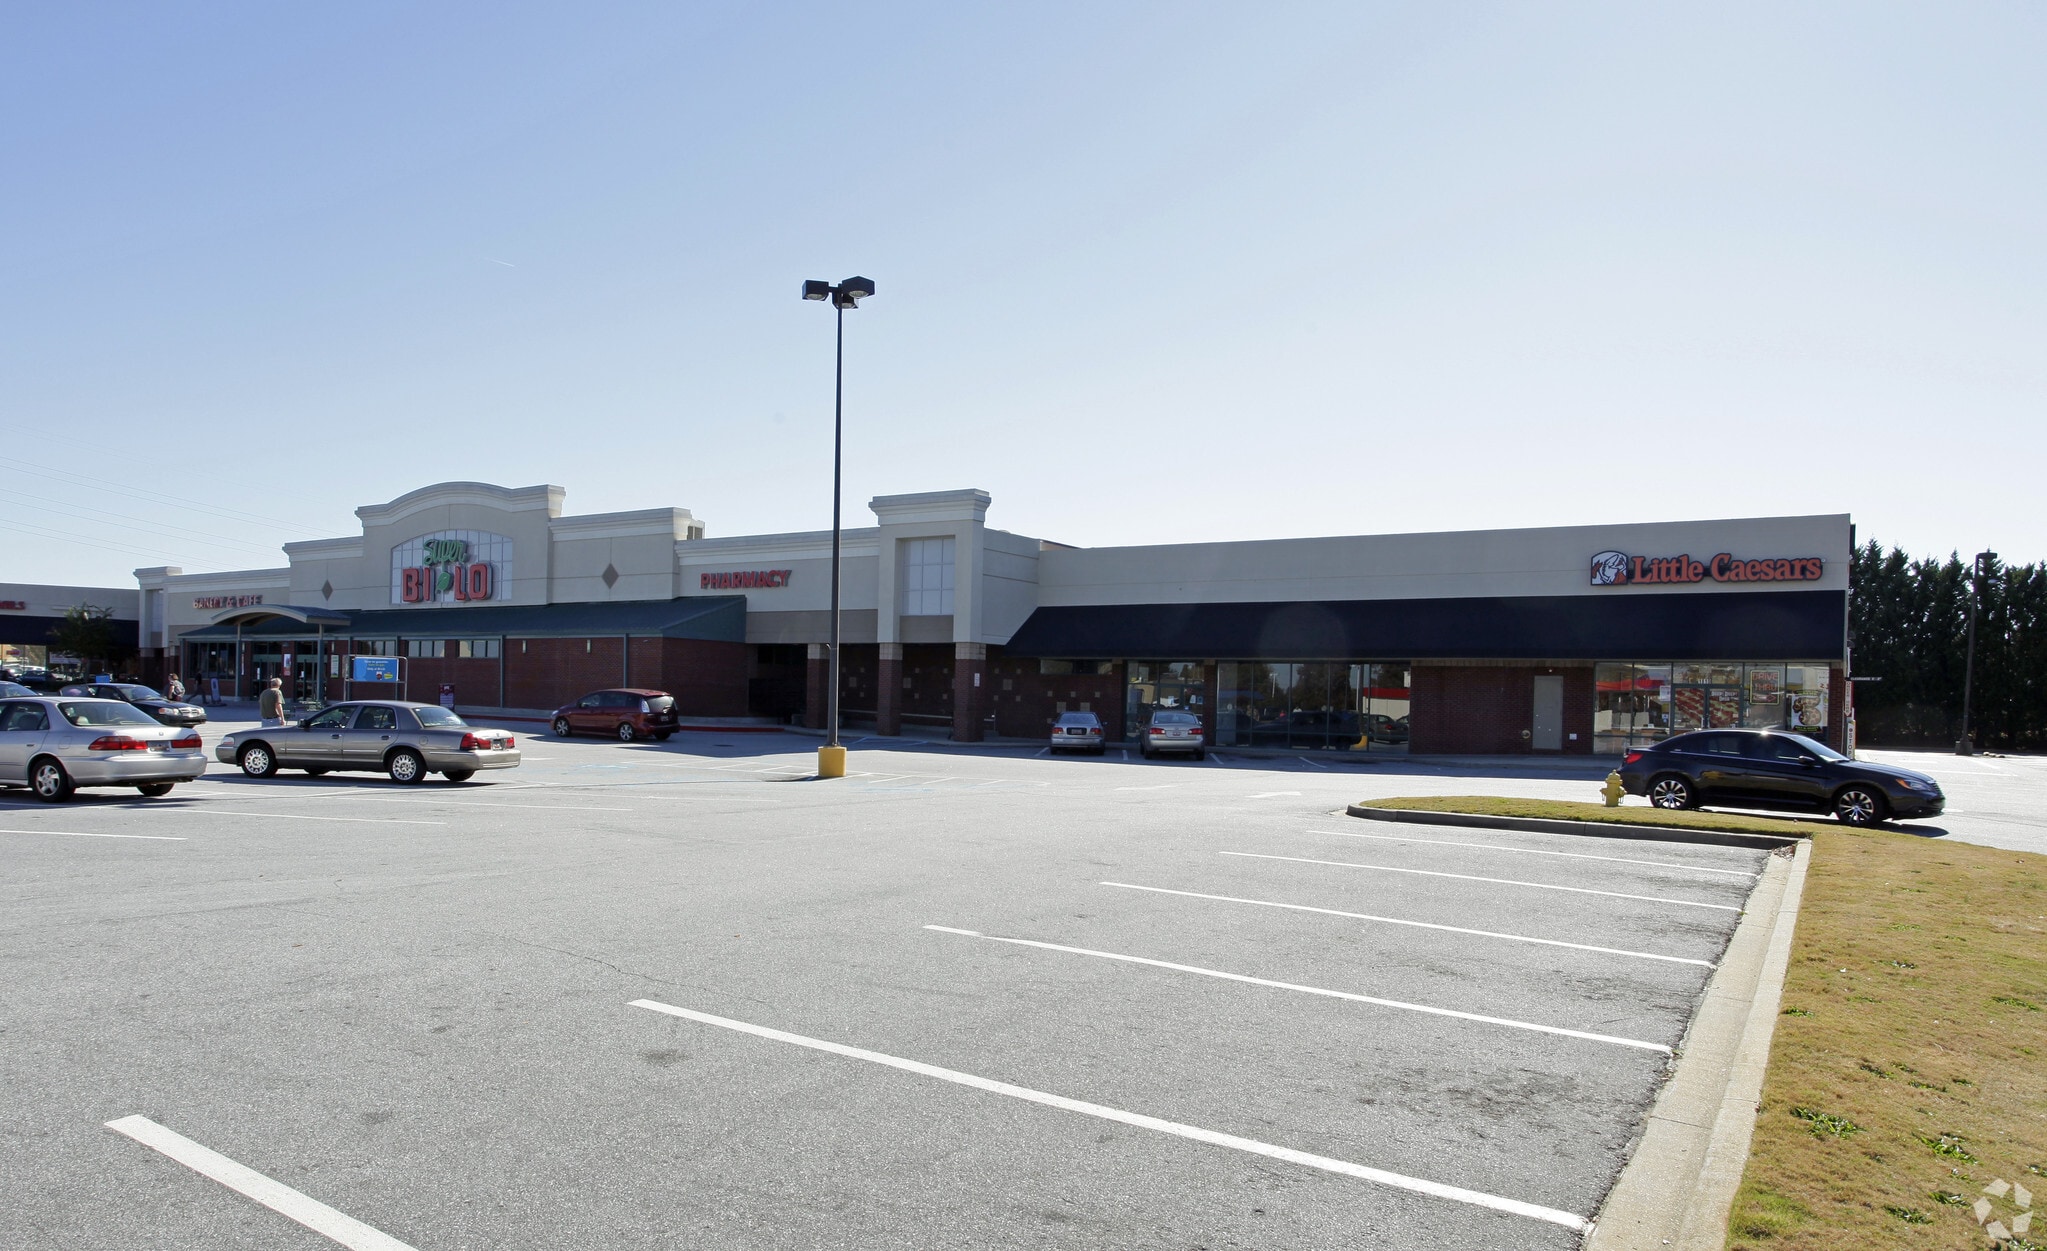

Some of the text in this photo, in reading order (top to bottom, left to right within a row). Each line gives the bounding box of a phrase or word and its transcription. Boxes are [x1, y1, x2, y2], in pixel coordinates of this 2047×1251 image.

[423, 539, 467, 566] Super
[1630, 553, 1823, 584] Little Caesars
[701, 570, 792, 589] PHARMACY
[193, 596, 225, 609] BAKERY
[1752, 672, 1778, 680] DRIVE
[1755, 683, 1776, 691] THRU
